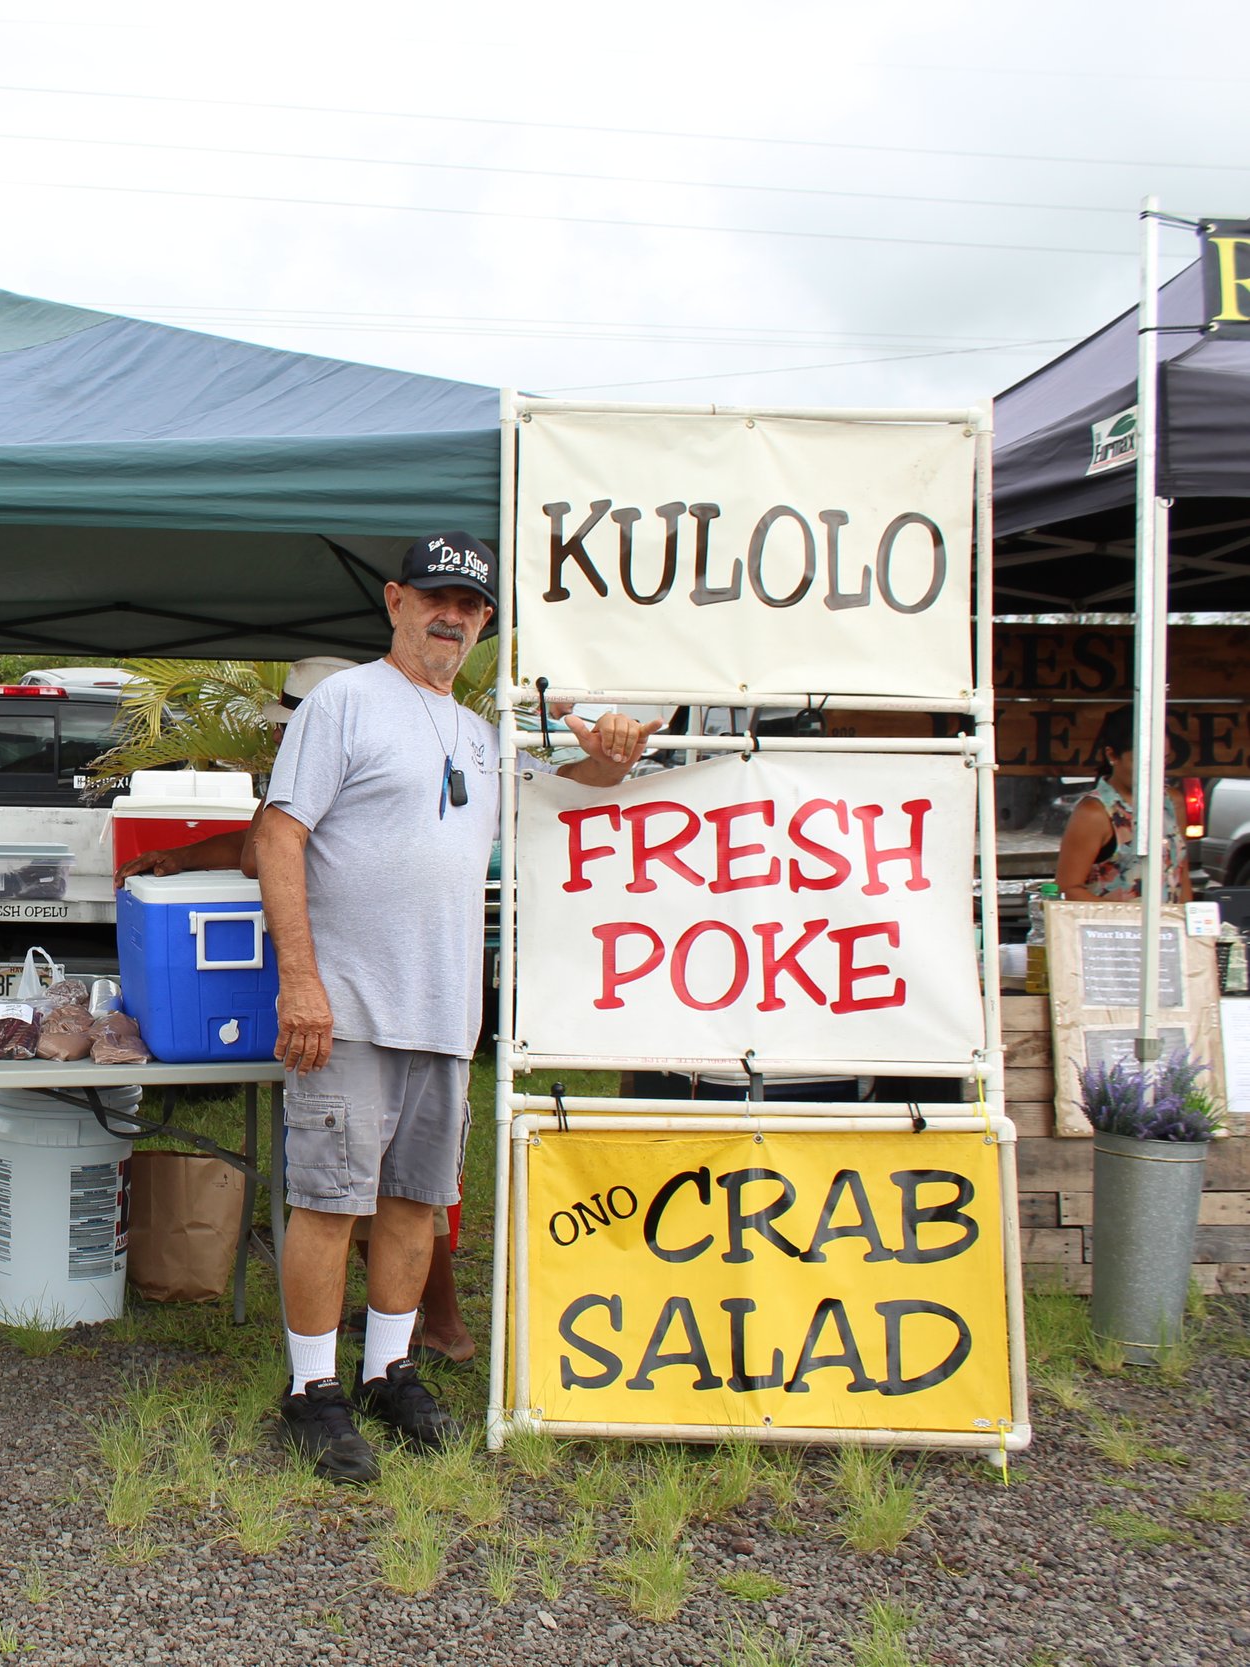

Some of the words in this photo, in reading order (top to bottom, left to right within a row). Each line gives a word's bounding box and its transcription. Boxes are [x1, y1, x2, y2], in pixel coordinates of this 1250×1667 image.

[427, 537, 445, 552] Eat
[427, 563, 488, 584] 936-9310
[440, 546, 461, 565] Da
[464, 549, 489, 576] Kine
[542, 498, 947, 614] KULOLO
[558, 798, 932, 896] FRESH
[24, 905, 69, 918] OPELU
[592, 918, 906, 1014] POKE
[549, 1185, 638, 1247] ONO
[643, 1166, 980, 1264] CRAB
[558, 1293, 972, 1396] SALAD
